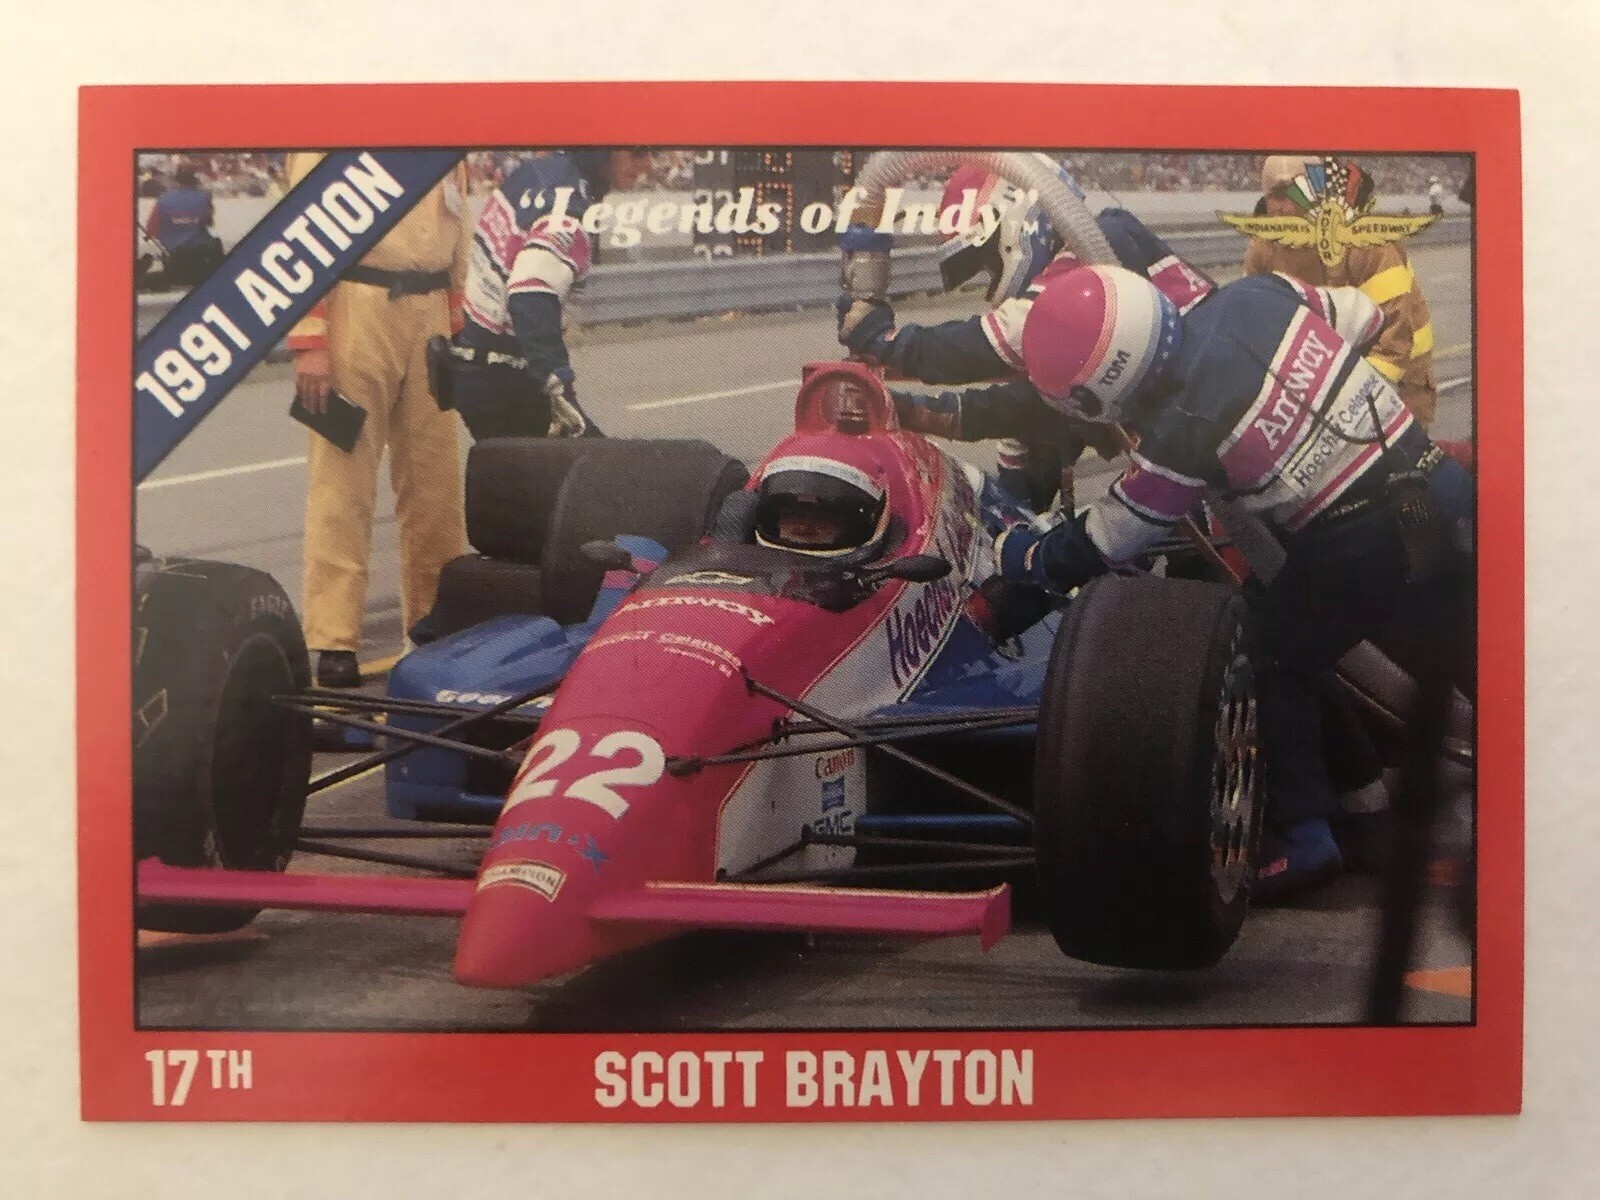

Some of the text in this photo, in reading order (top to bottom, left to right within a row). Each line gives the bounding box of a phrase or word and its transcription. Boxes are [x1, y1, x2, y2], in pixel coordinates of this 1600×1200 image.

[801, 187, 867, 235] of
[1320, 207, 1332, 261] MOTOR
[1351, 223, 1412, 235] SPEEDWAY
[135, 302, 252, 419] 1991
[234, 151, 405, 327] ACTION
[1099, 348, 1130, 385] TOM
[500, 728, 666, 820] 22
[594, 1049, 1034, 1108] SCOTT BRAYTON
